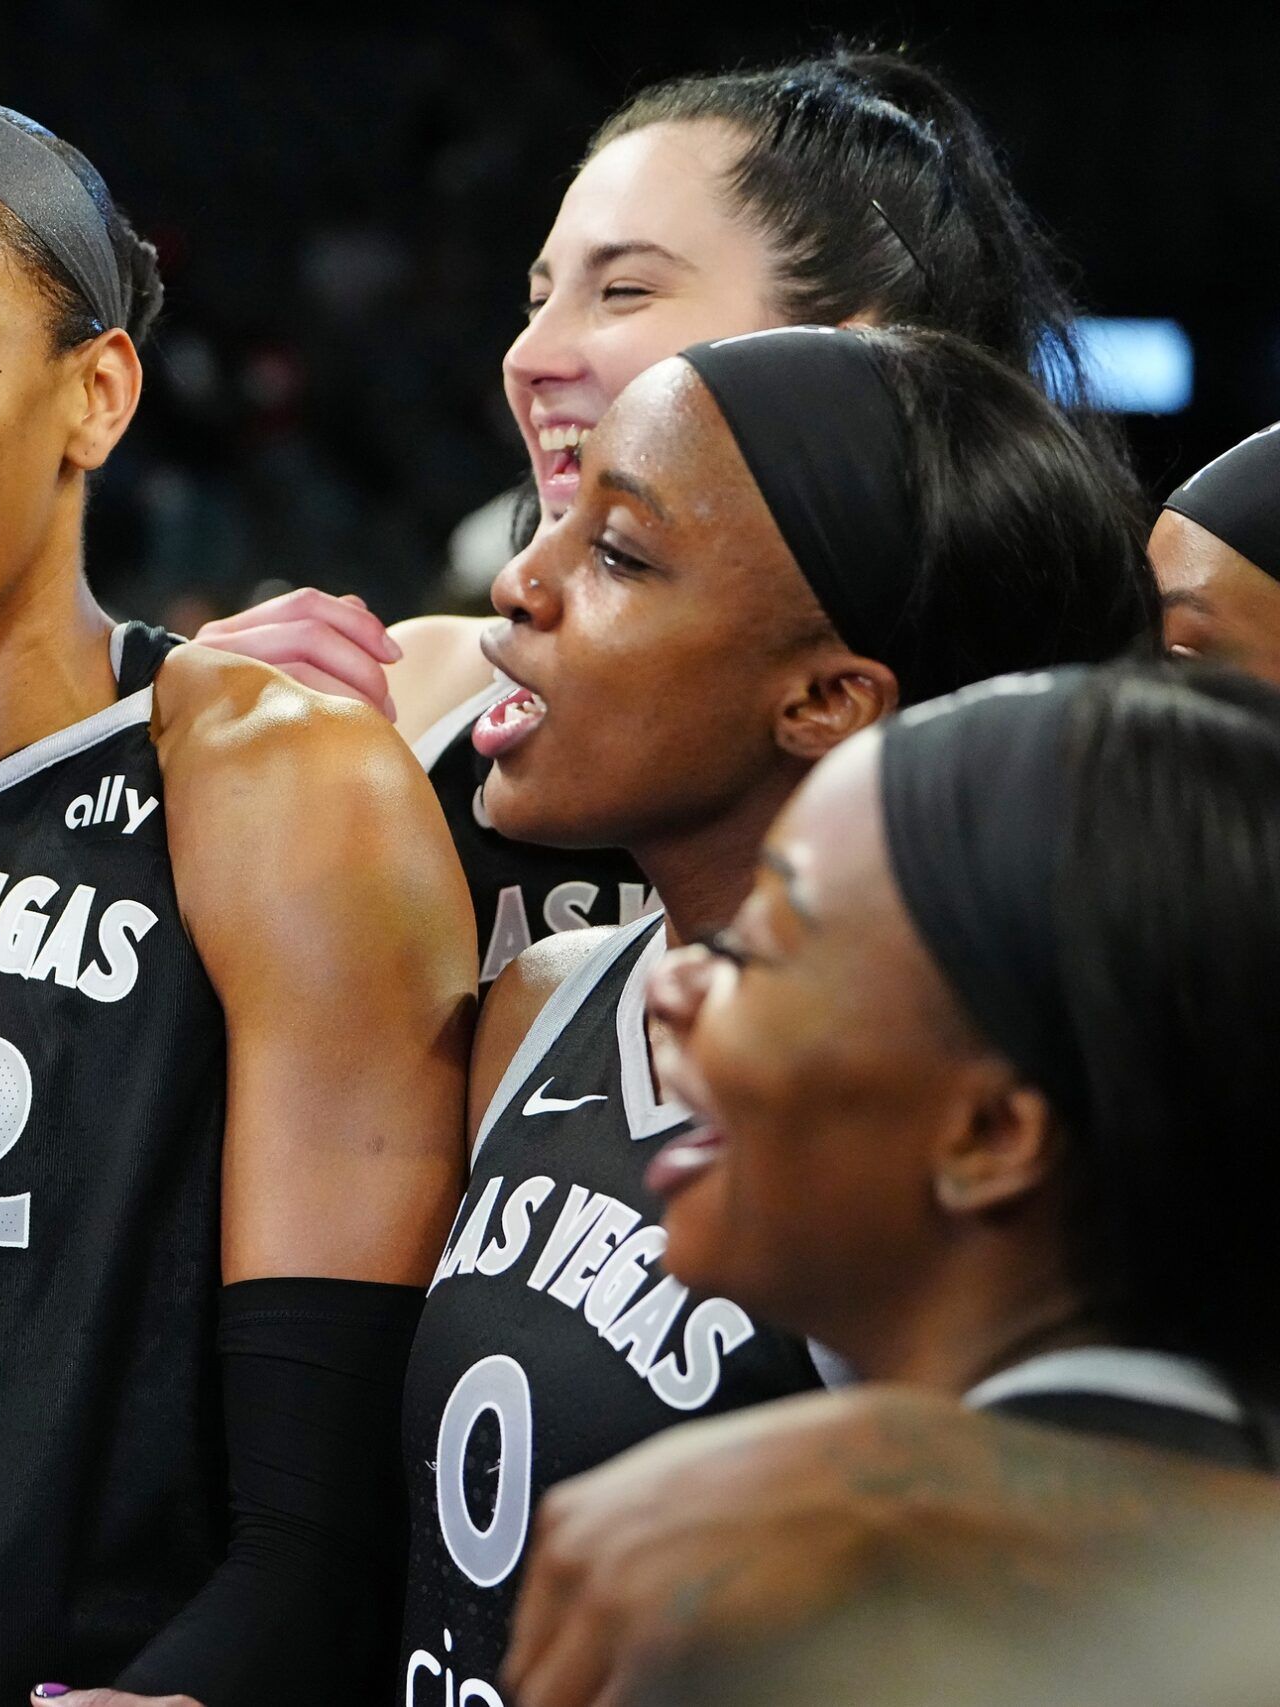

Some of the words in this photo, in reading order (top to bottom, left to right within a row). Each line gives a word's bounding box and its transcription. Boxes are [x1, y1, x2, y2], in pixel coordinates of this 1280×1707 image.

[64, 774, 160, 835] ally
[478, 881, 601, 985] AS
[526, 1183, 756, 1412] VEGAS
[435, 1353, 533, 1588] 0
